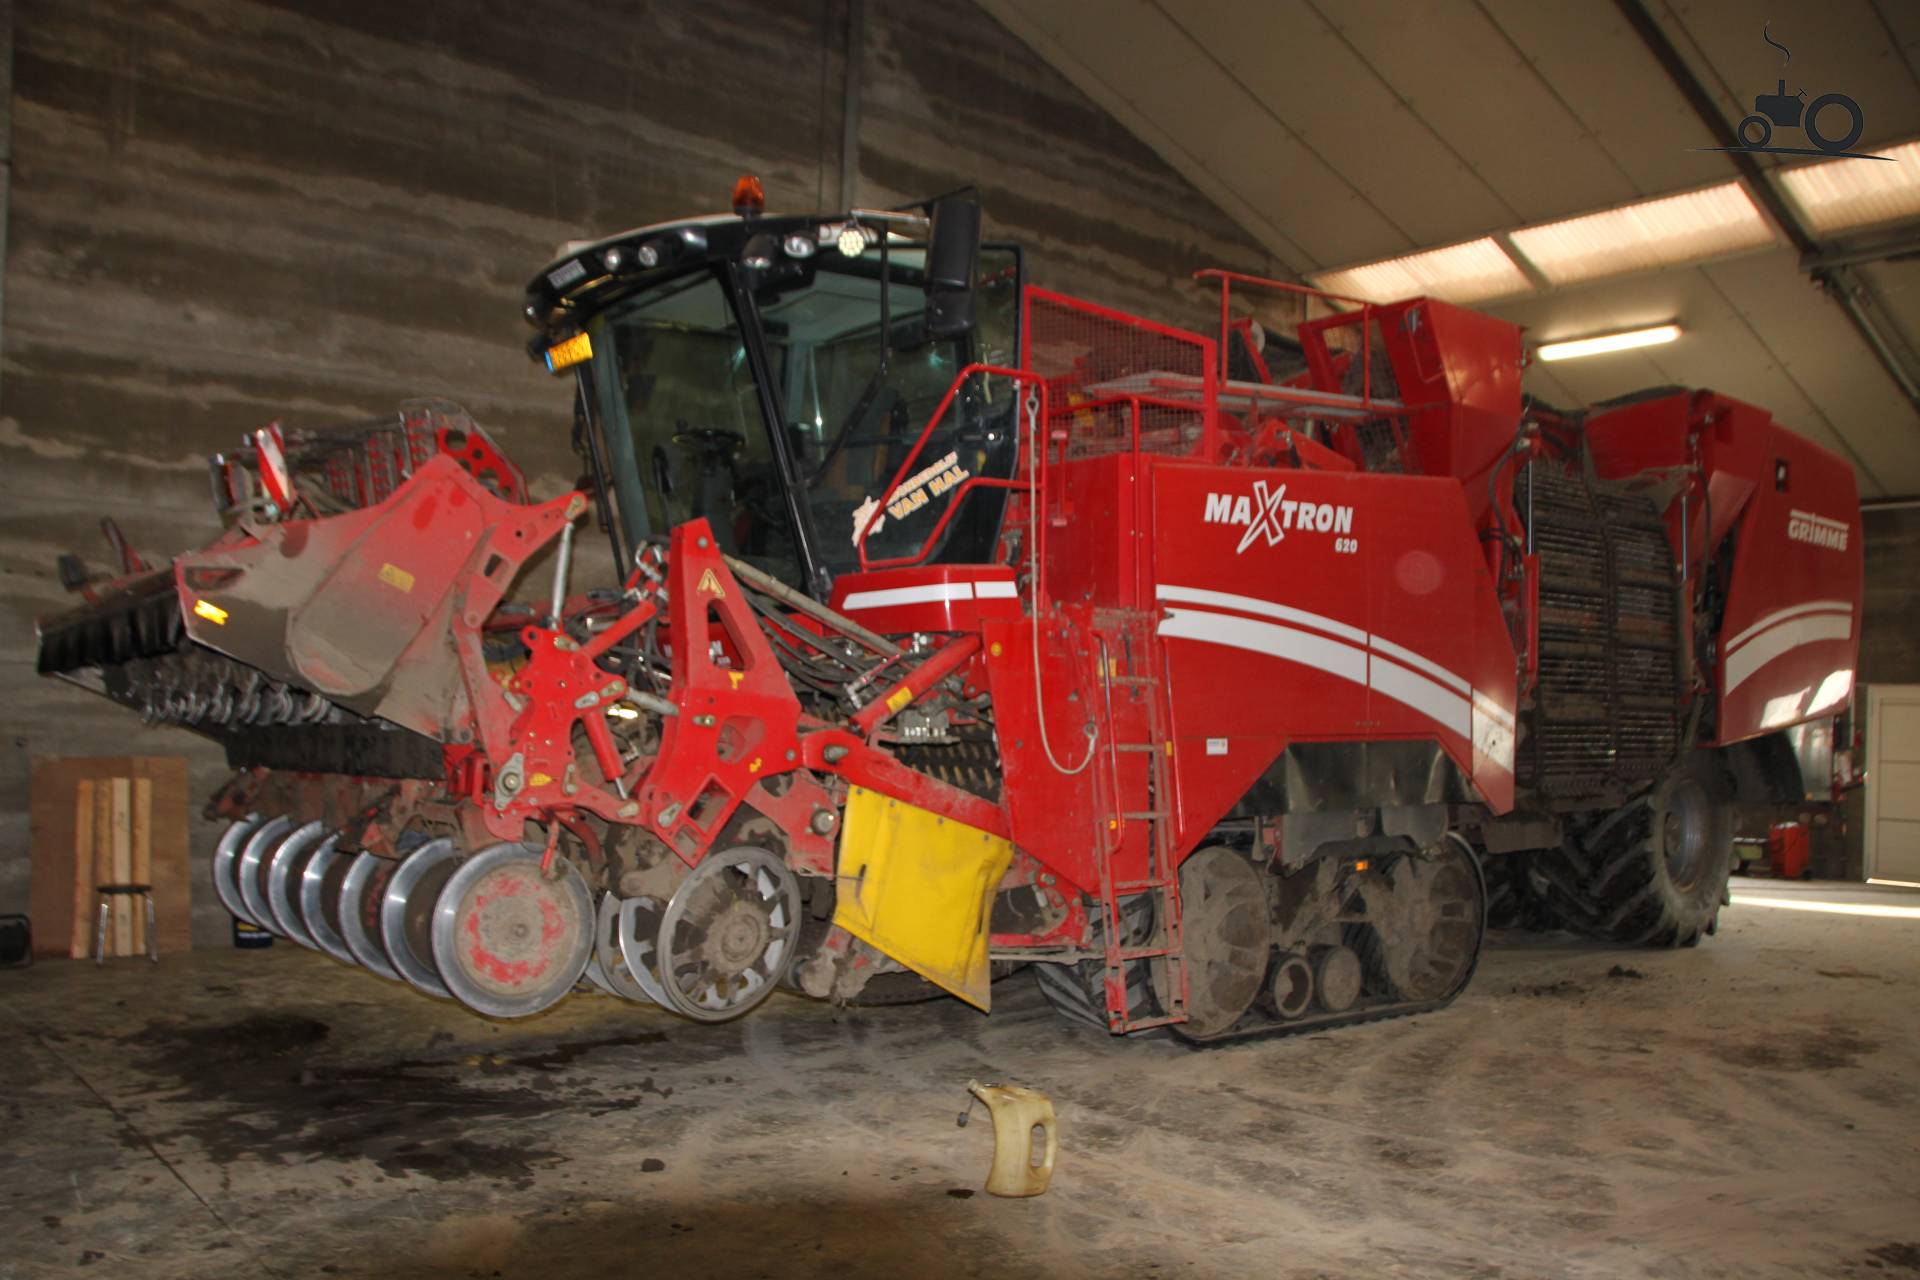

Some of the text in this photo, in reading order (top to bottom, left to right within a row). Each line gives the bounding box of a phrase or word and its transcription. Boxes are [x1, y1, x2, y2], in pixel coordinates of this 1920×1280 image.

[887, 488, 930, 520] VAN
[1204, 480, 1354, 555] MAXTRON
[1334, 537, 1358, 553] 620
[1787, 511, 1849, 552] GRIMME
